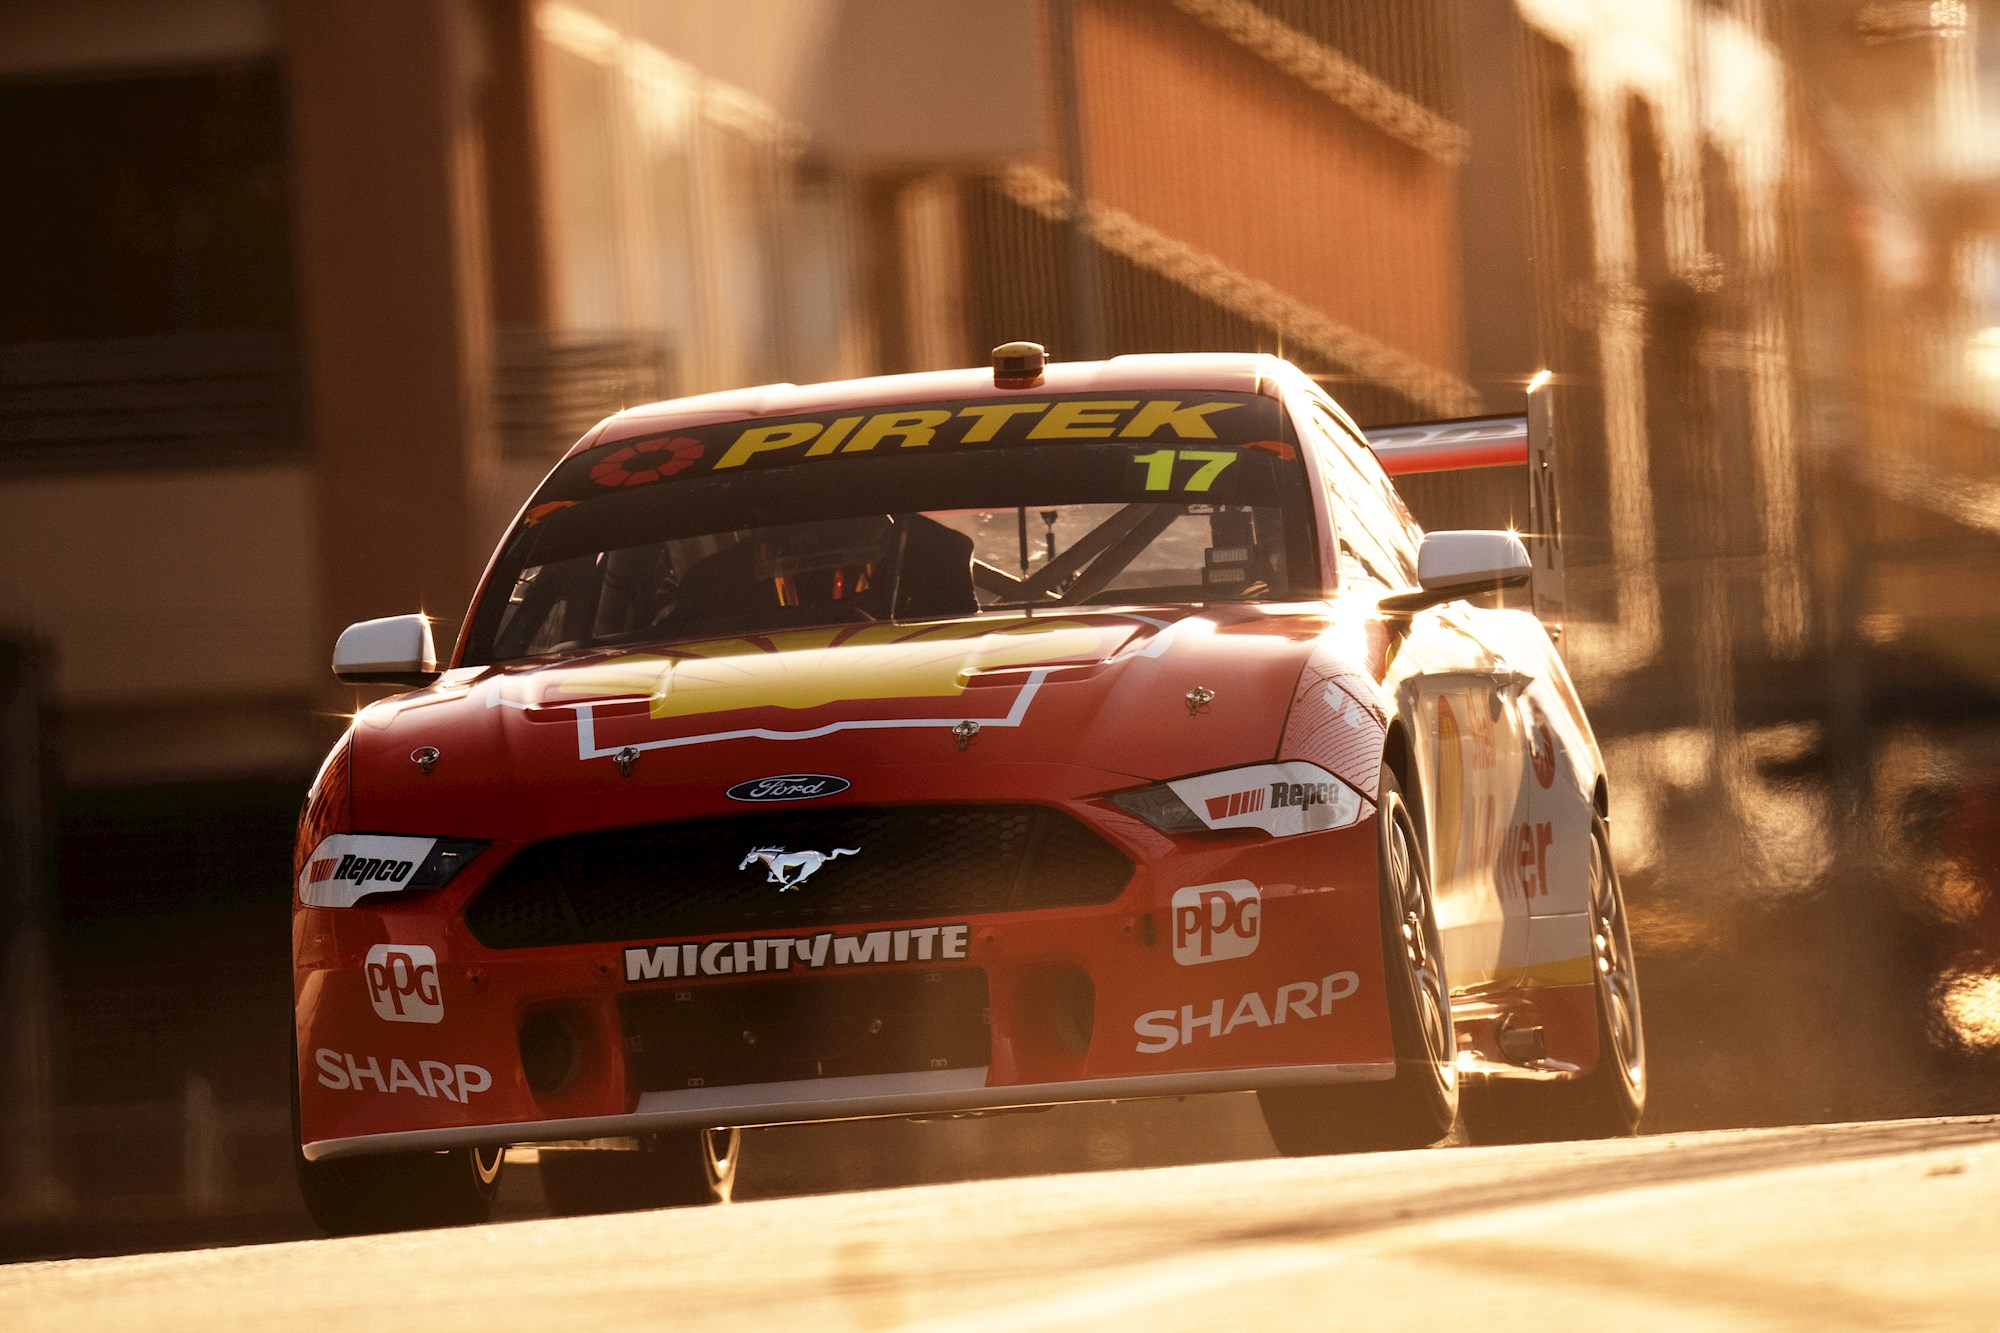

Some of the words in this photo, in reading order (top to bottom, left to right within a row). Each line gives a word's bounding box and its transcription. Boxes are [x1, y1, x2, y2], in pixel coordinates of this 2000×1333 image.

[713, 400, 1246, 470] PIRTEK
[1134, 450, 1237, 491] 17
[750, 777, 825, 799] Ford
[1270, 782, 1340, 811] Repco
[334, 853, 414, 885] Repco
[1177, 890, 1260, 956] PPG
[368, 951, 442, 1016] PPG
[1134, 971, 1360, 1054] SHARP
[315, 1048, 492, 1103] SHARP
